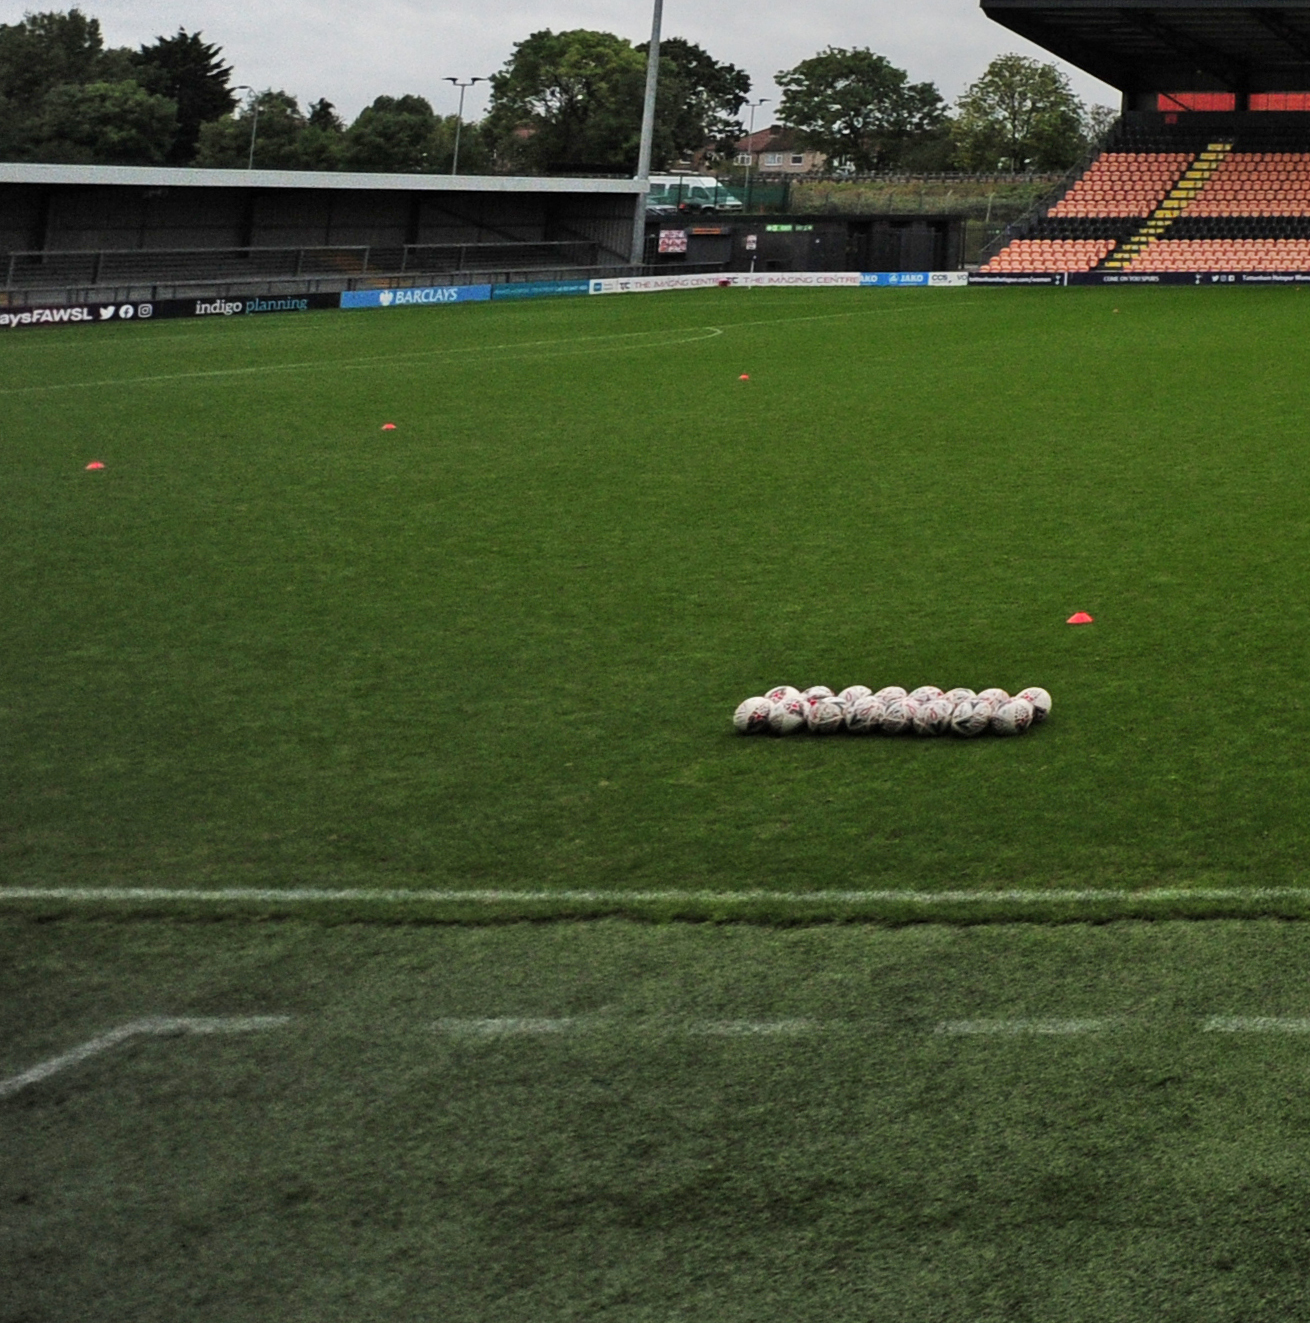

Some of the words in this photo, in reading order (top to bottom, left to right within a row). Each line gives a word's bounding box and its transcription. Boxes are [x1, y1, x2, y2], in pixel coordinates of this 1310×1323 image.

[860, 274, 878, 282] AKO
[900, 274, 924, 282] JAKO
[395, 288, 459, 304] BARCLAYS
[196, 299, 243, 315] indigo
[245, 297, 308, 315] planning
